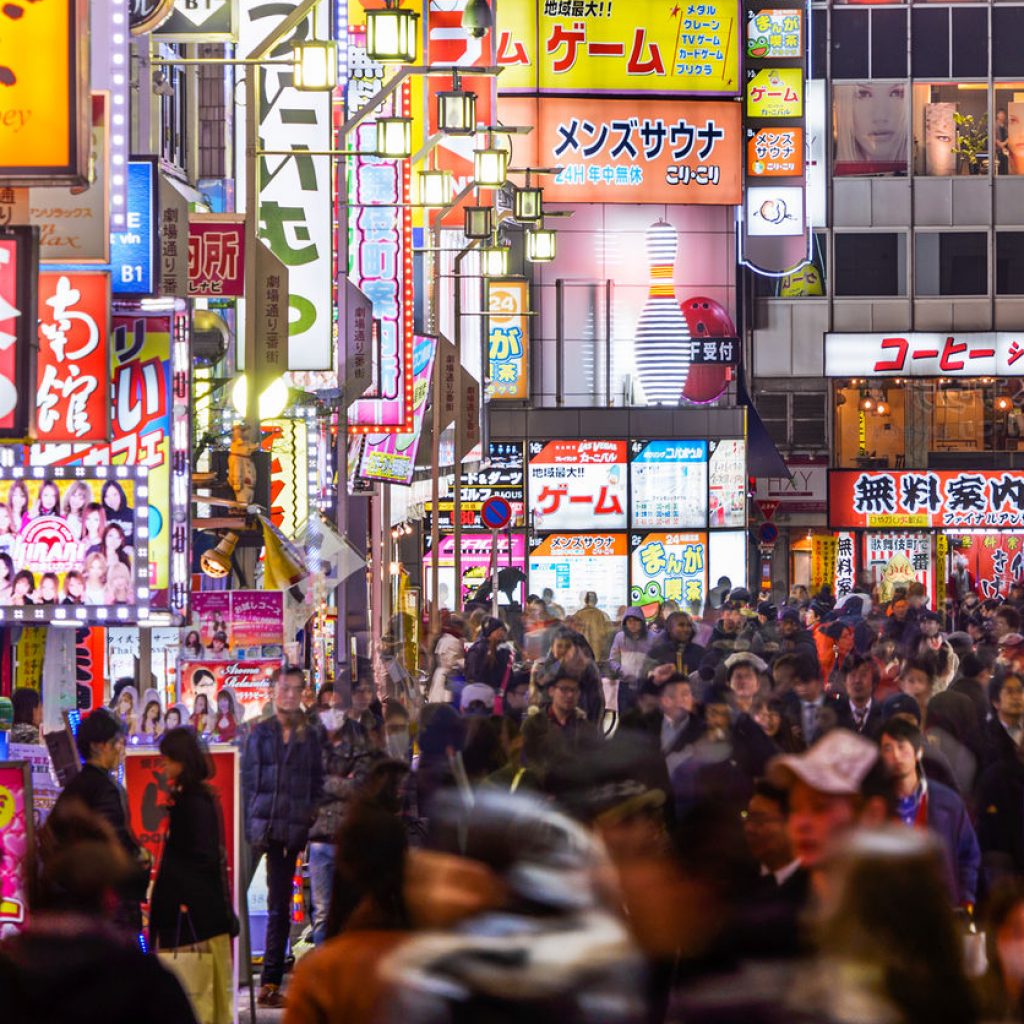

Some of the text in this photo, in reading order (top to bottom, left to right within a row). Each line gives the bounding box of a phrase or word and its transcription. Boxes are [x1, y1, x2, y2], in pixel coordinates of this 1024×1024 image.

[545, 0, 612, 18] 地域最大!!
[687, 4, 717, 16] メダル
[755, 14, 800, 33] まんが
[546, 22, 669, 77] ゲーム
[749, 86, 799, 104] ゲーム
[554, 119, 724, 161] メンズサウナ
[756, 146, 794, 160] サウナ
[588, 166, 642, 184] 年中無休
[162, 207, 178, 294] 劇場通り一番
[121, 265, 143, 283] B1
[264, 273, 279, 364] 劇場通り一番街
[874, 337, 996, 372] コーヒー
[537, 484, 625, 517] ゲーム
[641, 543, 705, 576] まんが
